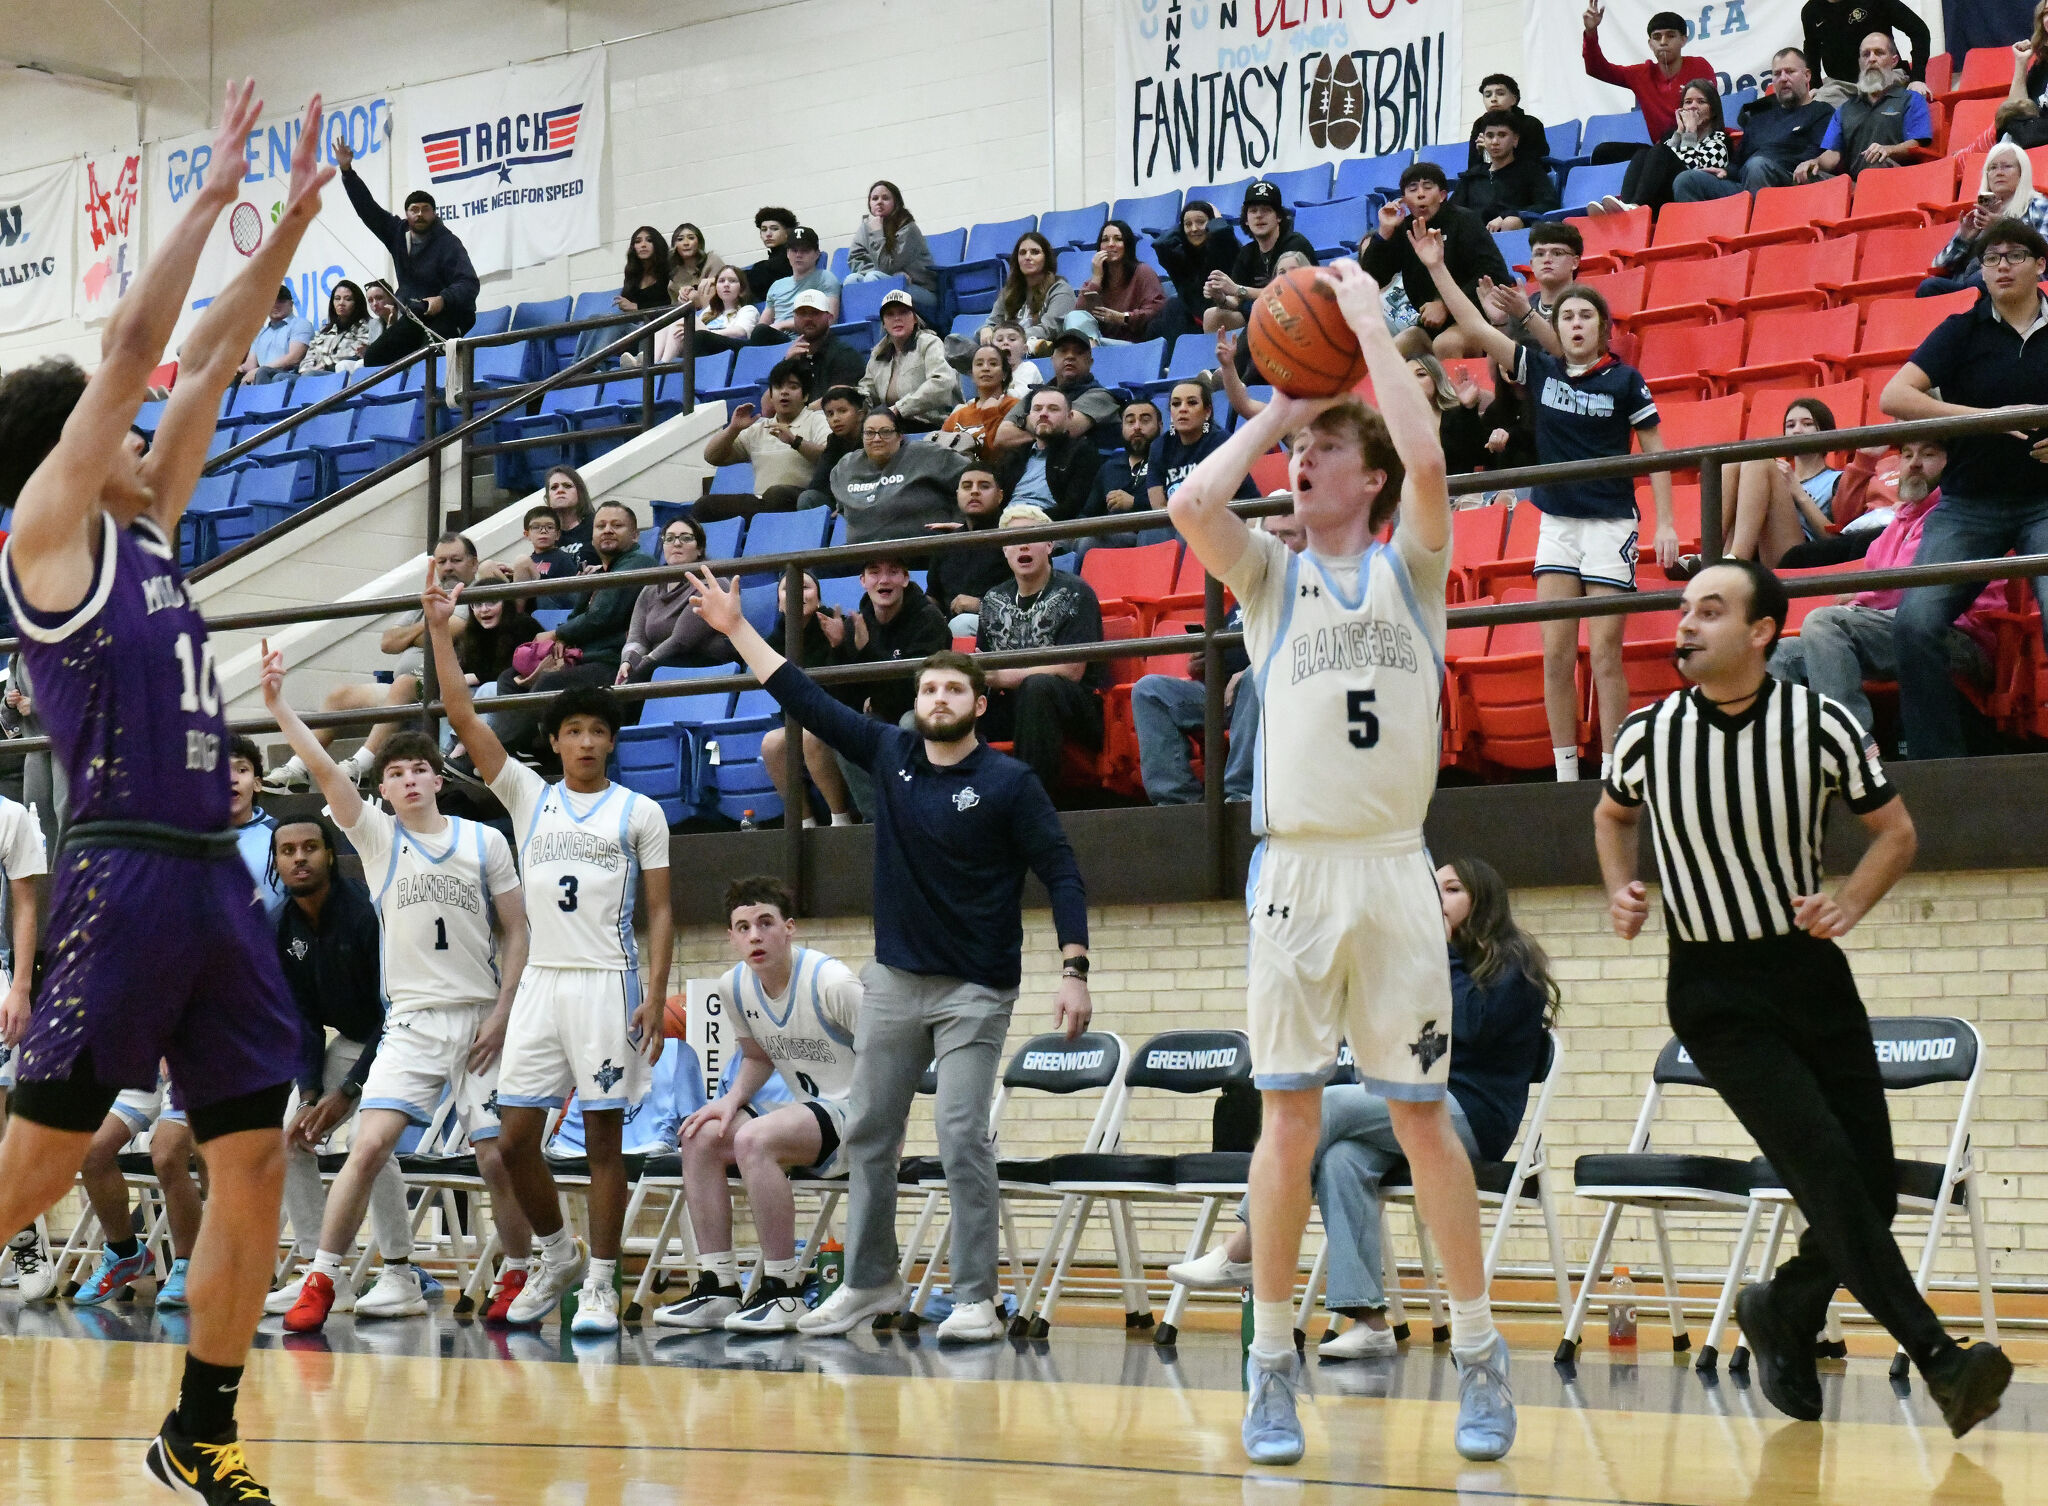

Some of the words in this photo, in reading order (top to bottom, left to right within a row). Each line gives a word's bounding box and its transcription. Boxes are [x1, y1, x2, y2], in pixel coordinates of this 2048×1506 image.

[1720, 0, 1750, 36] A
[1217, 38, 1273, 69] now
[444, 110, 558, 167] TRACK
[1132, 61, 1289, 187] FANTASY
[167, 98, 388, 203] GRENOOD
[462, 197, 489, 219] THE
[491, 189, 520, 212] NEED
[522, 187, 545, 206] FOR
[545, 178, 584, 203] SPEED
[794, 228, 805, 239] T
[1291, 620, 1418, 686] RANGERS
[1347, 689, 1380, 749] 5
[530, 831, 620, 873] RANGERS
[397, 873, 480, 915] RANGERS
[558, 875, 579, 912] 3
[434, 916, 449, 950] 1
[1022, 1049, 1105, 1072] GREENWOOD
[1145, 1047, 1238, 1070] GREENWOOD
